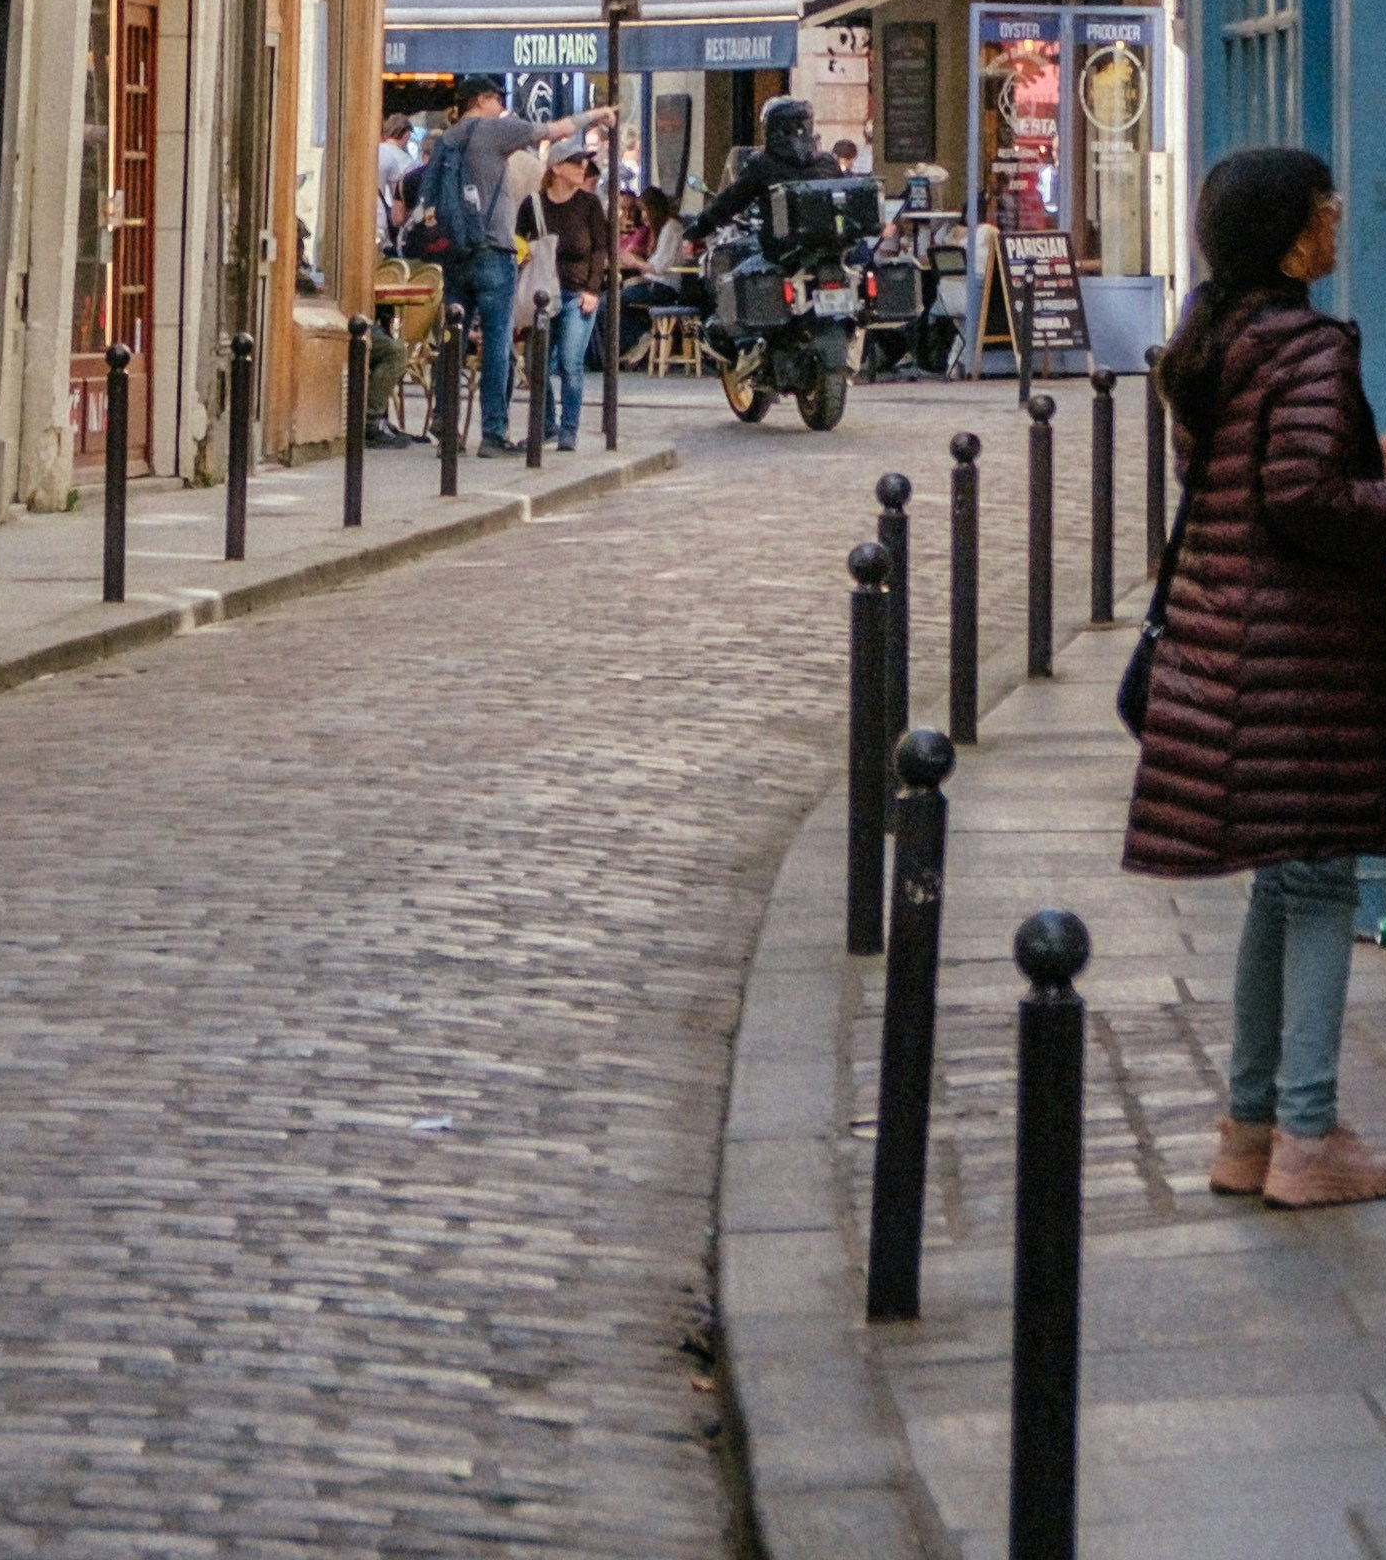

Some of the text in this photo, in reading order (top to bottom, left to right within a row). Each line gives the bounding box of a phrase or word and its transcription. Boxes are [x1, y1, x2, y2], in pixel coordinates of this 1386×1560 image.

[999, 22, 1141, 41] OYSTER PRODUCER
[513, 32, 598, 67] OSTRA PARIS
[705, 36, 774, 62] RESTAURANT
[1005, 236, 1069, 260] PARISIAN
